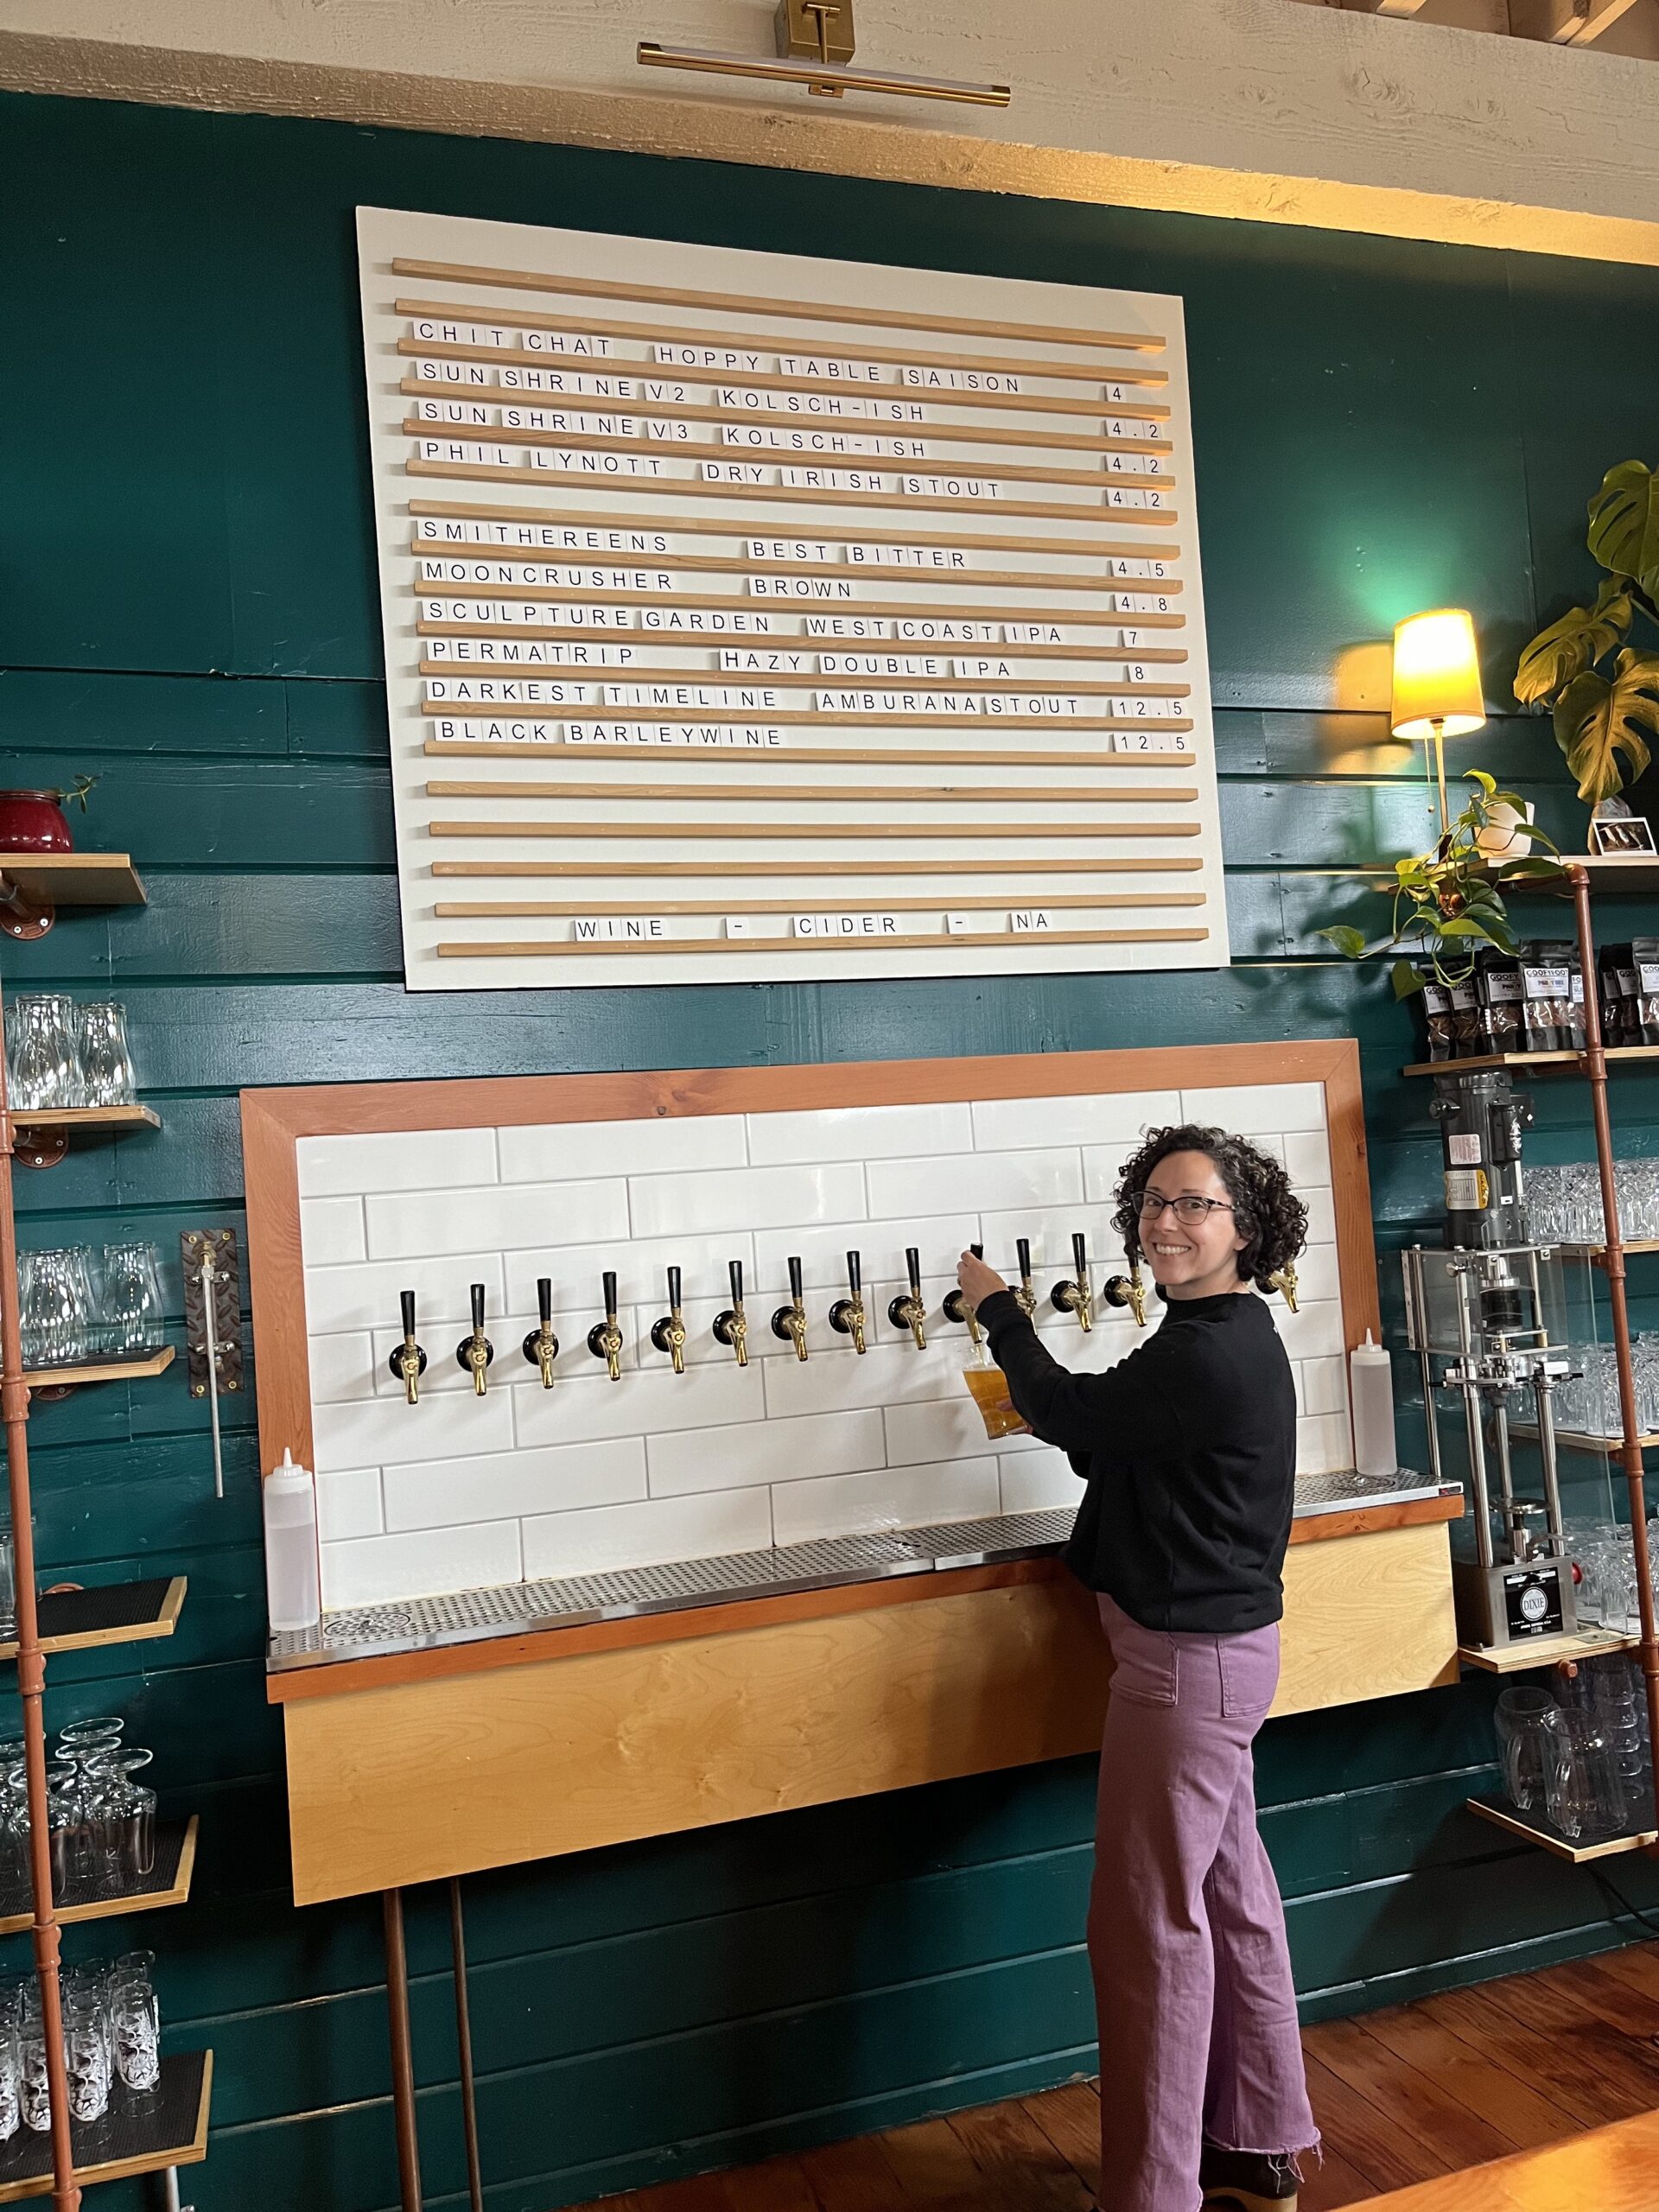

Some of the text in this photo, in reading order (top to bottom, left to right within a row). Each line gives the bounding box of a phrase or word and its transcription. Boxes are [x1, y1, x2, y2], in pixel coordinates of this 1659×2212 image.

[419, 323, 1122, 400] CHIT CHAT HOPPY TABLE SAISON 4
[423, 363, 1159, 438] SUN SHRINE V2 KOLSCH-ISH 4.2
[425, 403, 1158, 474] SUN SHRINE V3 KOLSCH-ISH 4.2
[427, 442, 1160, 507] PHIL LYNOTT DRY IRISH STOUT 4.2
[424, 521, 1164, 577] SMITHEREENS BEST BITTER 4.5
[426, 563, 1167, 611] MOONCRUSHER BROWN 4.8
[429, 602, 1137, 645] SCULPTURE GARDEN WEST COAST IPA 7
[433, 642, 1144, 680] PERMATRIP HAZY DOUBLE IPA 8
[432, 682, 1182, 715] DARKEST TIMELINE AMBURANA STOUT 12.5
[442, 721, 1185, 750] BLACK BARLEYWINE 12.5
[577, 920, 662, 938] WINE
[799, 918, 895, 933] CIDER
[1017, 913, 1047, 928] NA
[1523, 1597, 1545, 1611] DIXIE
